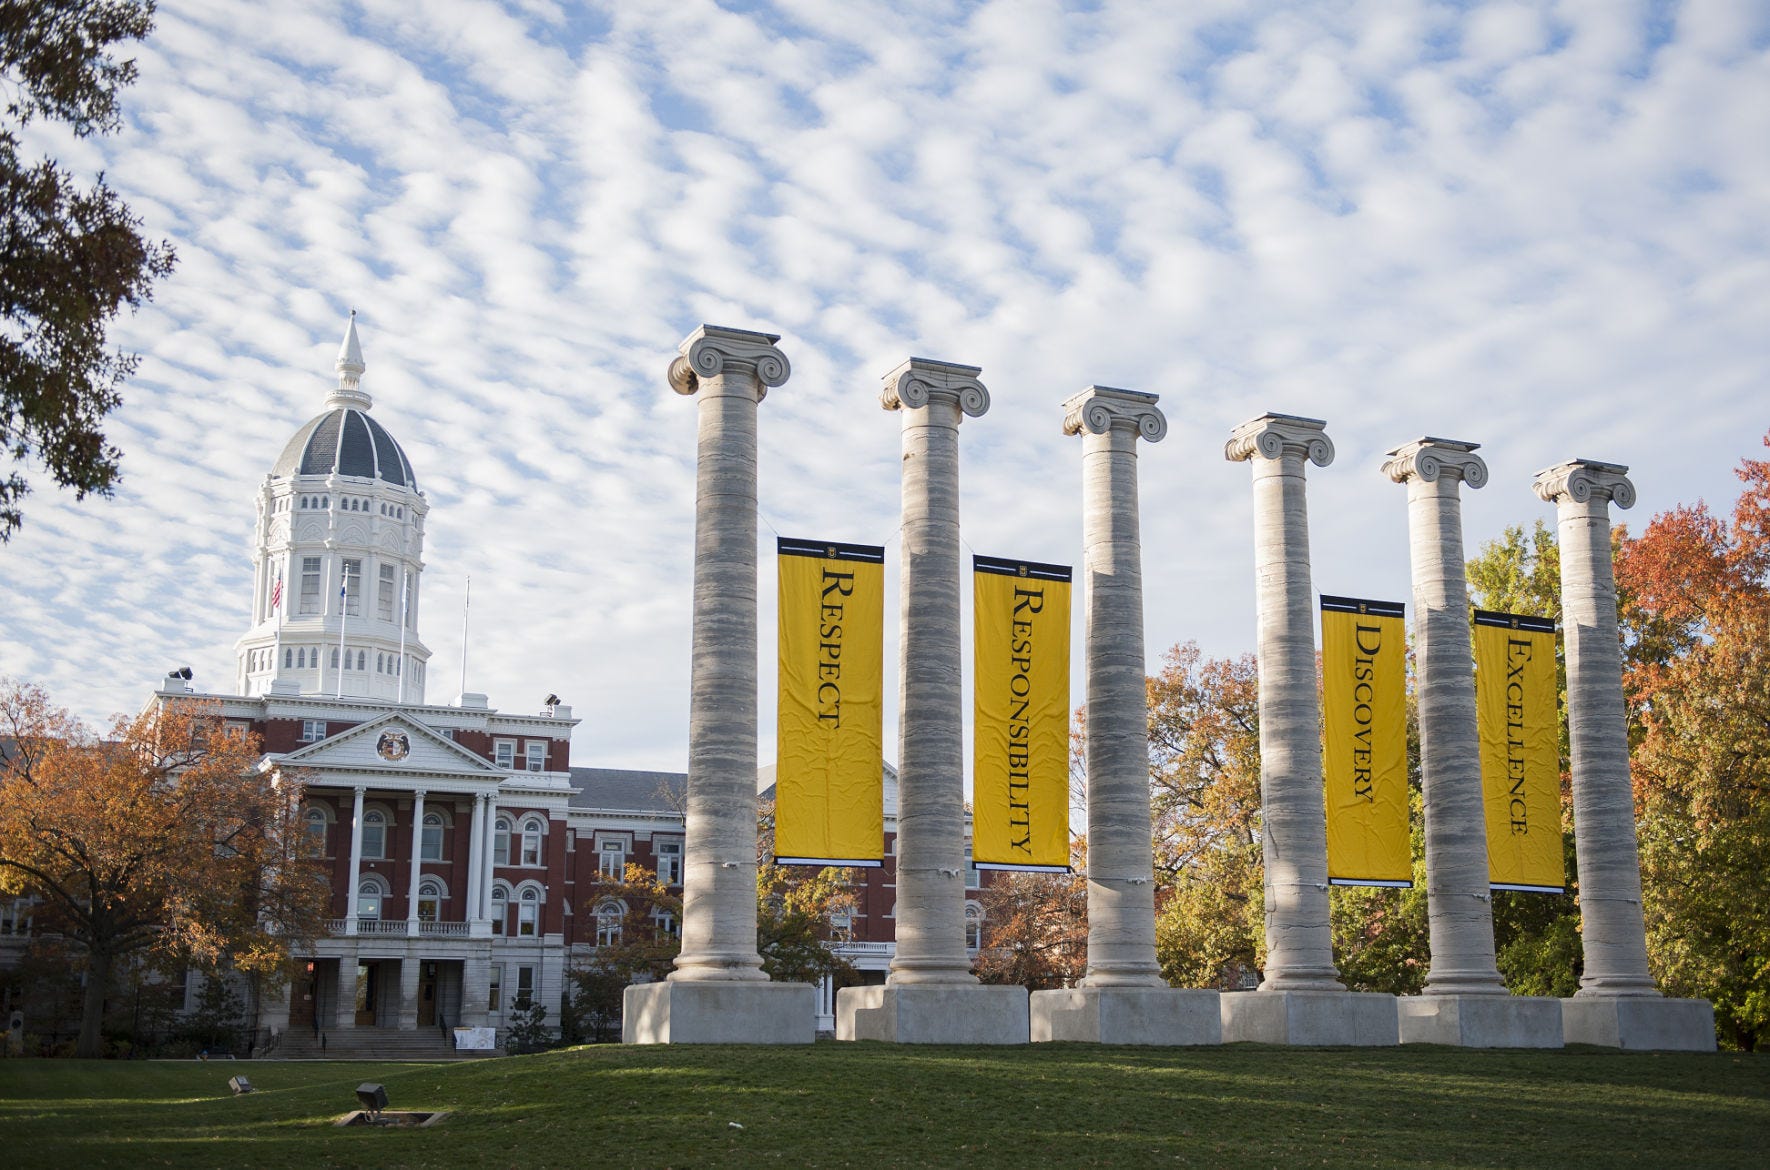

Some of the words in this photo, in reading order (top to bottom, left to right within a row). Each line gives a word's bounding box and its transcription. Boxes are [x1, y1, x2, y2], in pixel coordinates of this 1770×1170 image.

[817, 566, 855, 730] RESPECT
[1008, 584, 1044, 856] RESPONSIBILITY
[1353, 622, 1382, 803] DISCOVERY
[1506, 635, 1533, 837] EXCELLENCE
